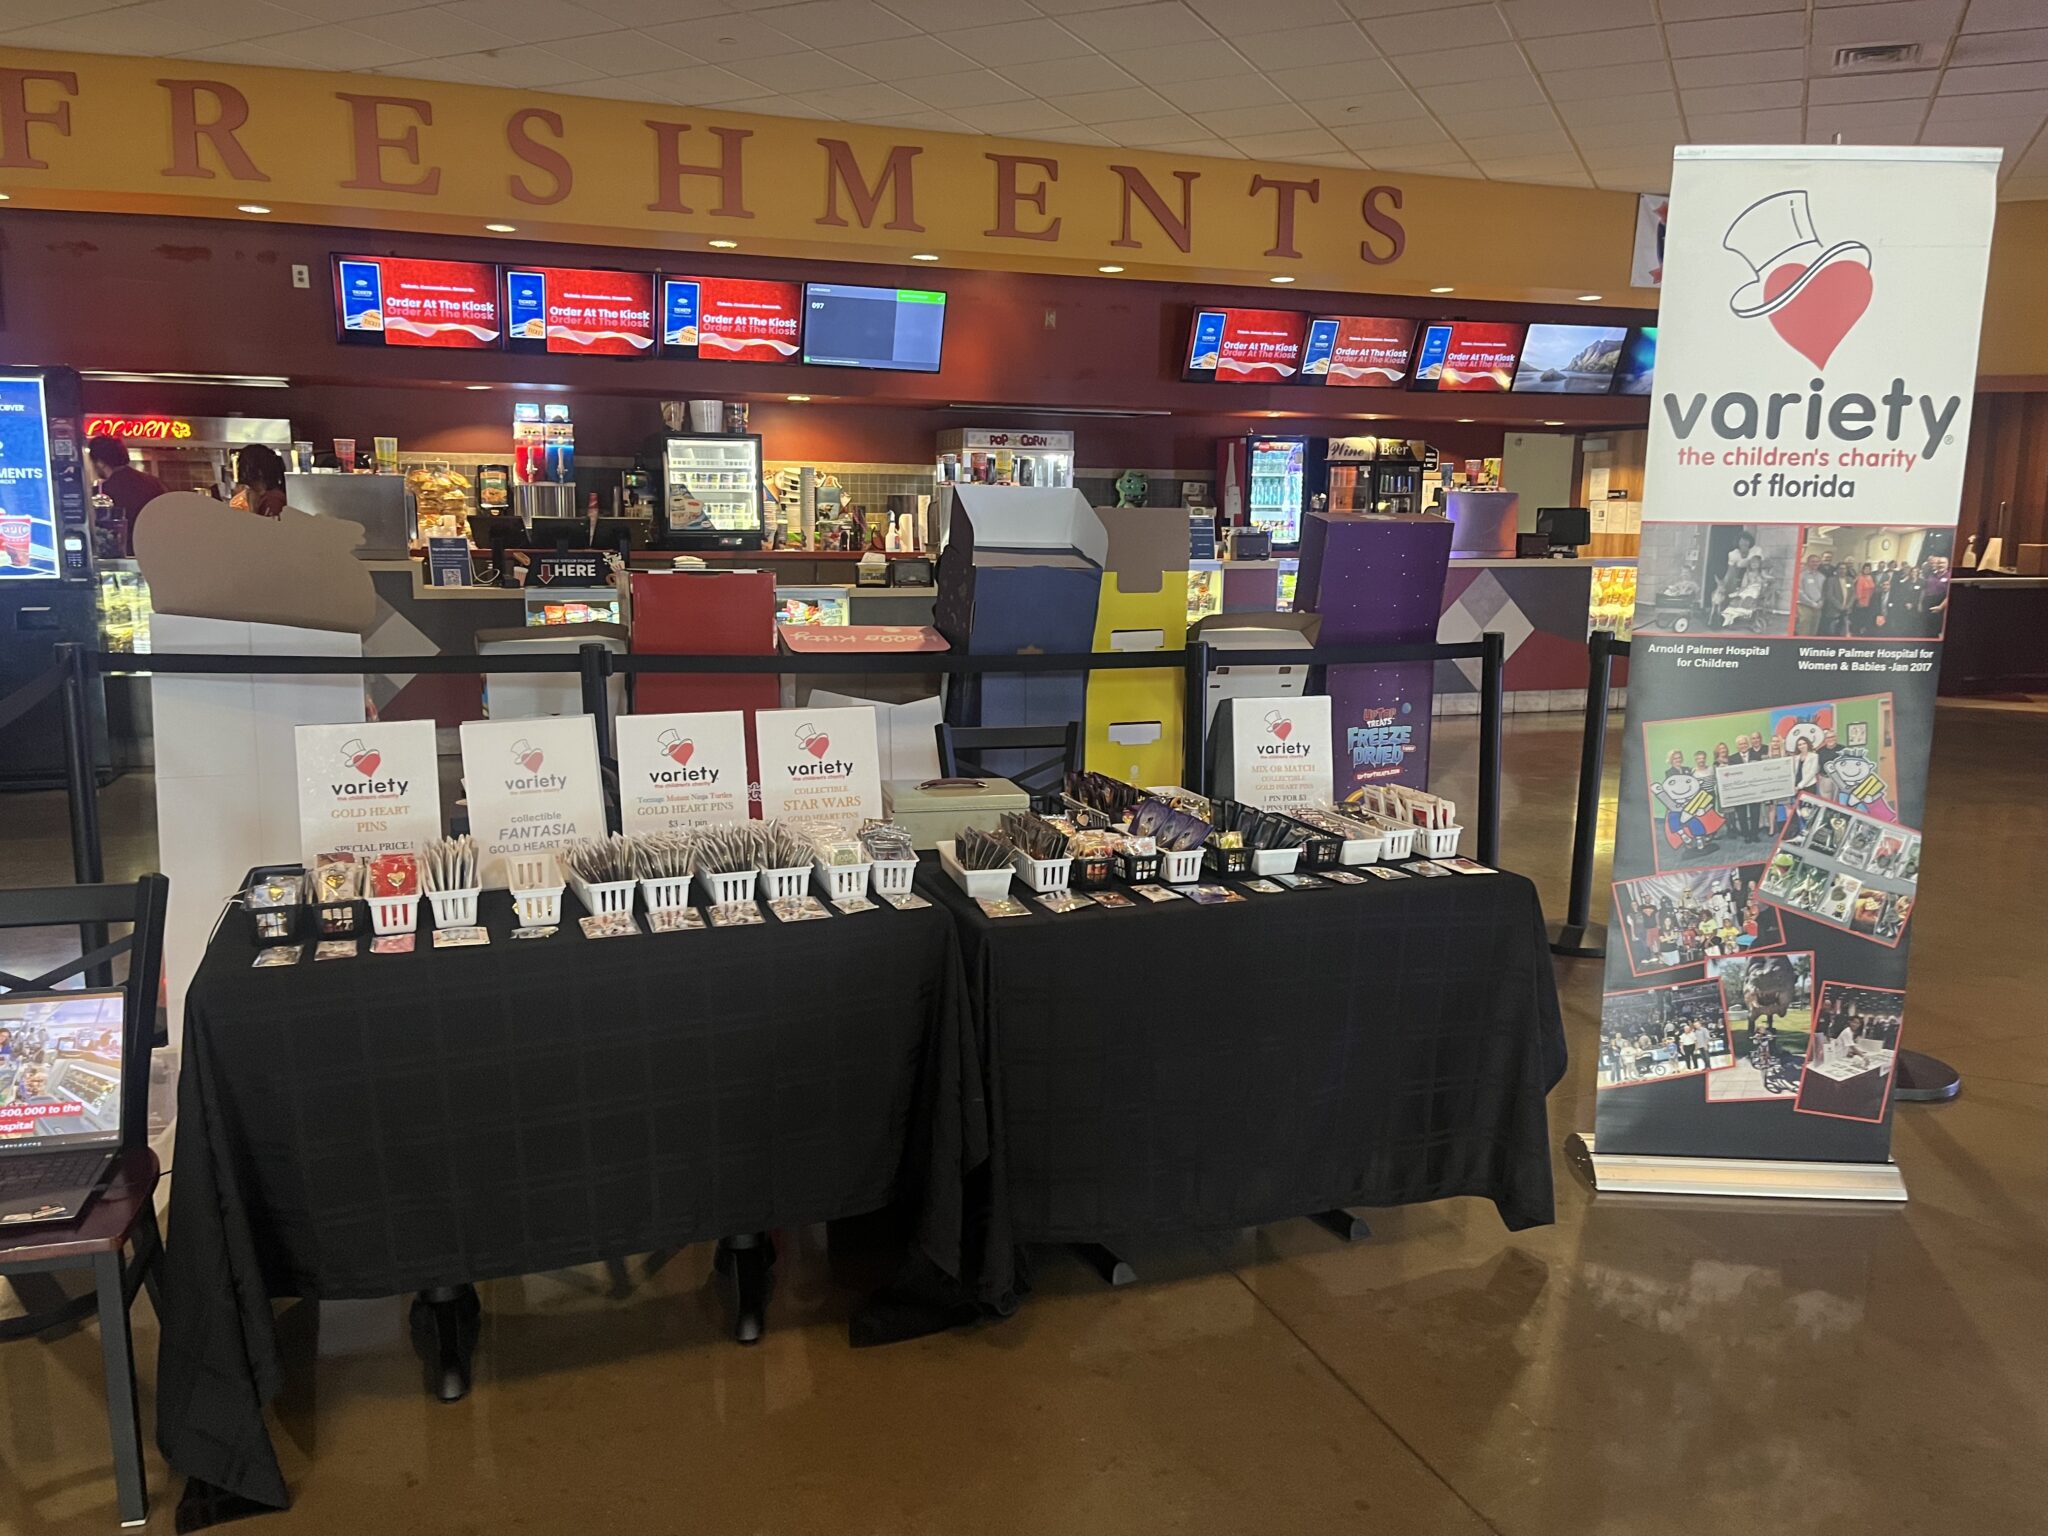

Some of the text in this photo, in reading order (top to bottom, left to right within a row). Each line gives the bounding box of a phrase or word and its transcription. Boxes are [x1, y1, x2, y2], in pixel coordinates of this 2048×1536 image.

[386, 297, 494, 312] Order At The Kiosk
[811, 302, 824, 310] 097
[550, 306, 581, 316] Order
[584, 308, 597, 317] At
[598, 309, 618, 318] The
[620, 310, 649, 320] Kiosk
[703, 314, 733, 324] Order
[735, 316, 747, 325] At
[749, 317, 767, 326] The
[769, 318, 797, 328] Kiosk
[1224, 341, 1248, 350] Order
[1260, 343, 1274, 351] The
[1276, 343, 1298, 352] Kiosk
[1336, 348, 1358, 356] Order
[1386, 349, 1408, 358] Kiosk
[1448, 352, 1515, 362] Order At The Kiosk
[1663, 378, 1961, 460] variety
[990, 434, 1048, 446] POP CORN
[1330, 442, 1366, 457] Wine
[1380, 442, 1410, 456] Beer
[1678, 446, 1917, 472] the children's charity
[0, 467, 43, 478] MENTS
[1733, 472, 1855, 498] of florida
[554, 564, 596, 576] HERE
[1648, 644, 1770, 657] Arnold Palmer Hospital
[1799, 647, 1934, 660] Winnie Palmer Hospital for
[1677, 658, 1739, 668] for Children
[1798, 661, 1838, 670] Women
[1840, 662, 1849, 671] &
[1851, 662, 1886, 671] Babies
[1910, 663, 1932, 672] 2017
[1366, 718, 1392, 727] TREATS
[1348, 726, 1412, 754] FREEZE
[1257, 742, 1311, 756] variety
[1353, 744, 1404, 768] DRIED
[649, 766, 719, 783] variety
[788, 760, 853, 776] variety
[332, 778, 408, 796] variety
[505, 774, 567, 790] variety
[794, 786, 848, 795] COLLECTIBLE
[637, 802, 734, 815] GOLD HEART PINS
[784, 795, 861, 811] STAR WARS
[331, 806, 410, 818] GOLD HEART
[511, 812, 561, 823] collectible
[357, 821, 387, 832] PINS
[499, 823, 576, 840] FANTASIA
[335, 844, 377, 852] SPECIAL
[379, 841, 409, 850] PRICE
[489, 844, 520, 854] GOLD
[524, 840, 560, 851] HEART
[48, 1106, 60, 1114] to
[62, 1104, 81, 1113] the
